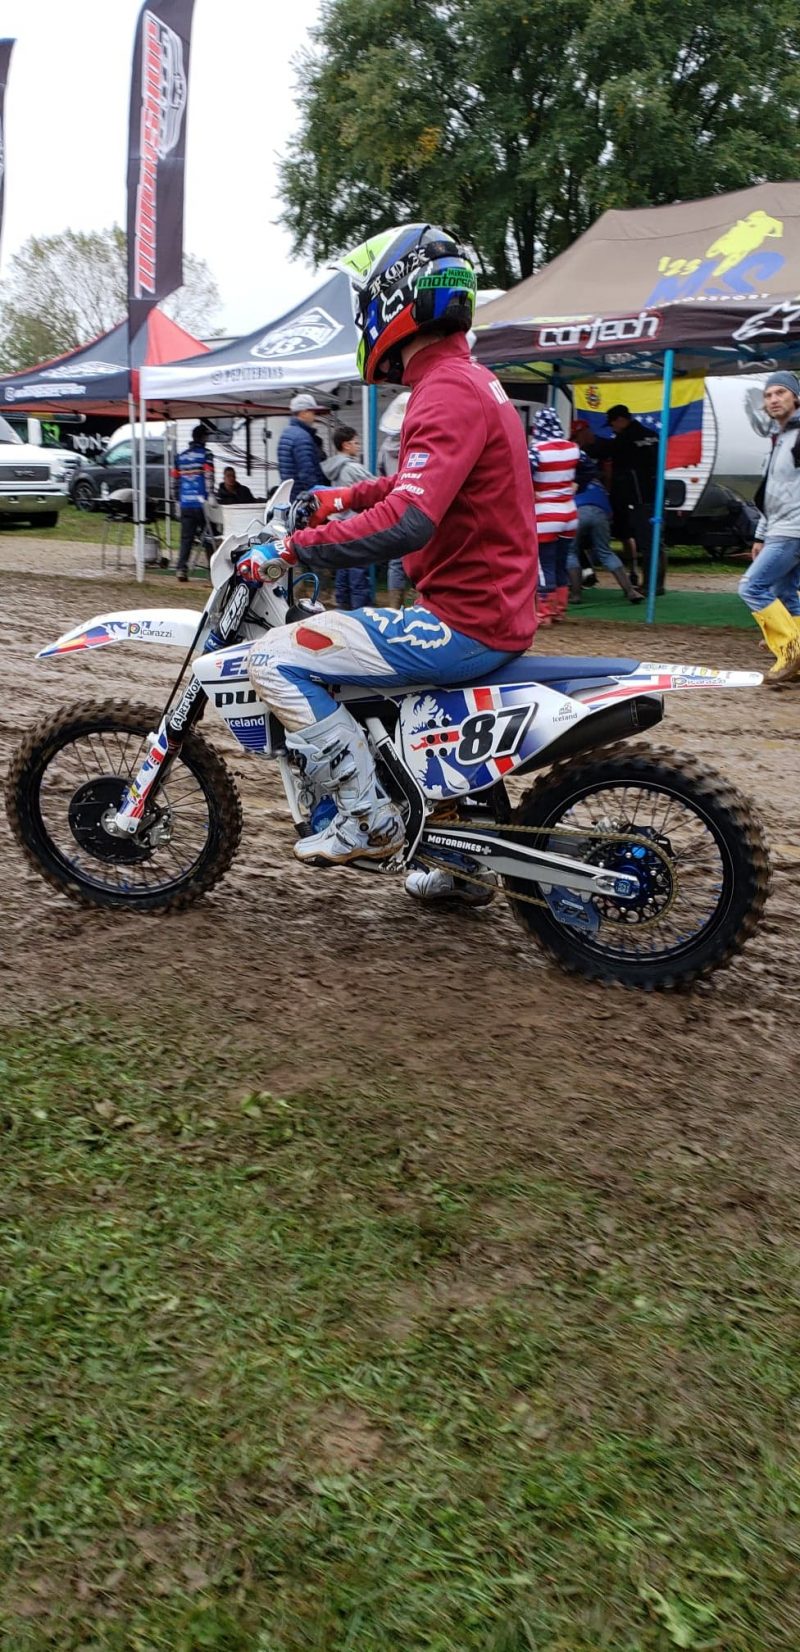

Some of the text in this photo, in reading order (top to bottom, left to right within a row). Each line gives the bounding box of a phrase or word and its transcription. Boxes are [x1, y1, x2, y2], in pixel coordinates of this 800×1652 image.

[215, 690, 263, 708] pu
[226, 717, 264, 728] Iceland
[553, 713, 578, 723] Iceland
[457, 704, 535, 763] 87
